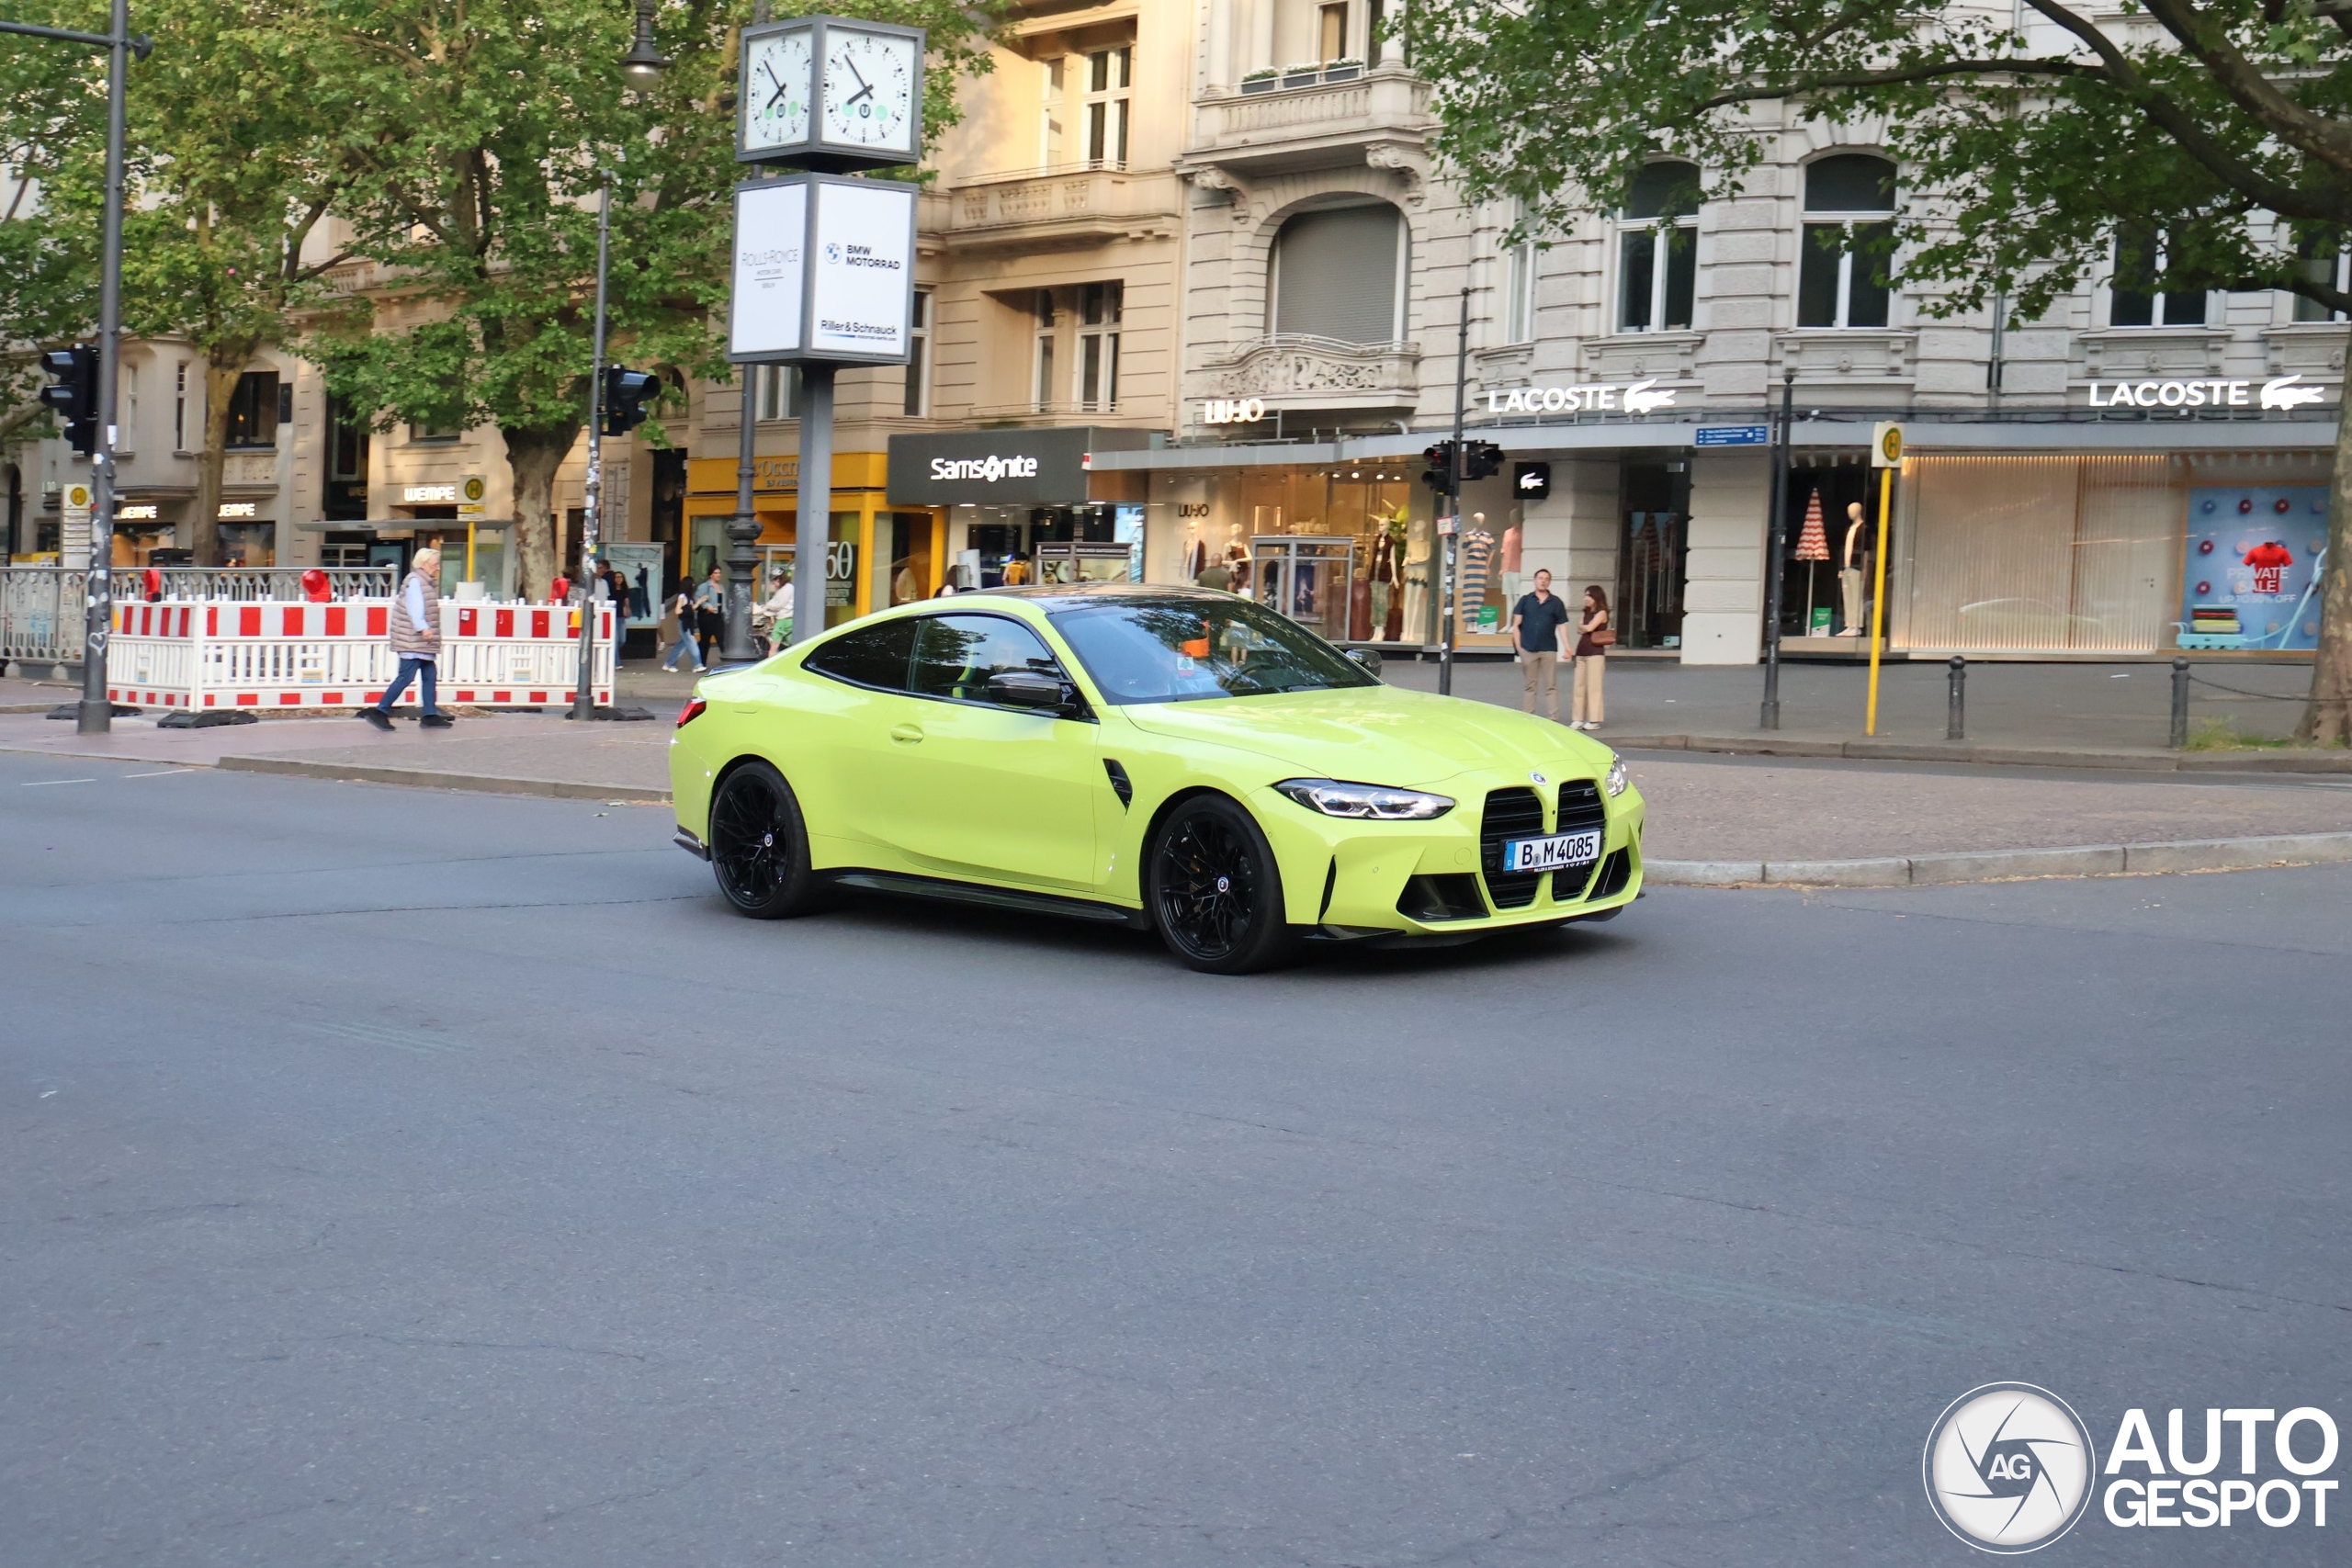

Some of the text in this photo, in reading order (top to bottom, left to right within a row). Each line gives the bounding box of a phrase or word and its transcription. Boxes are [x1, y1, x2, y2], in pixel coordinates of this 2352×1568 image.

[846, 244, 872, 255] BMW
[741, 249, 798, 266] ROLLS-ROYCE
[846, 256, 900, 269] MOTORRAD
[821, 320, 898, 334] Riller & Schnauck
[1487, 385, 1617, 413] LACOSTE
[2088, 380, 2251, 407] LACOSTE
[930, 455, 1038, 482] Samsonite
[403, 486, 456, 502] WEMPE
[2227, 567, 2290, 580] PRIVATE
[2239, 580, 2278, 592] SALE
[2275, 594, 2297, 604] OFF
[1521, 844, 1533, 866] B
